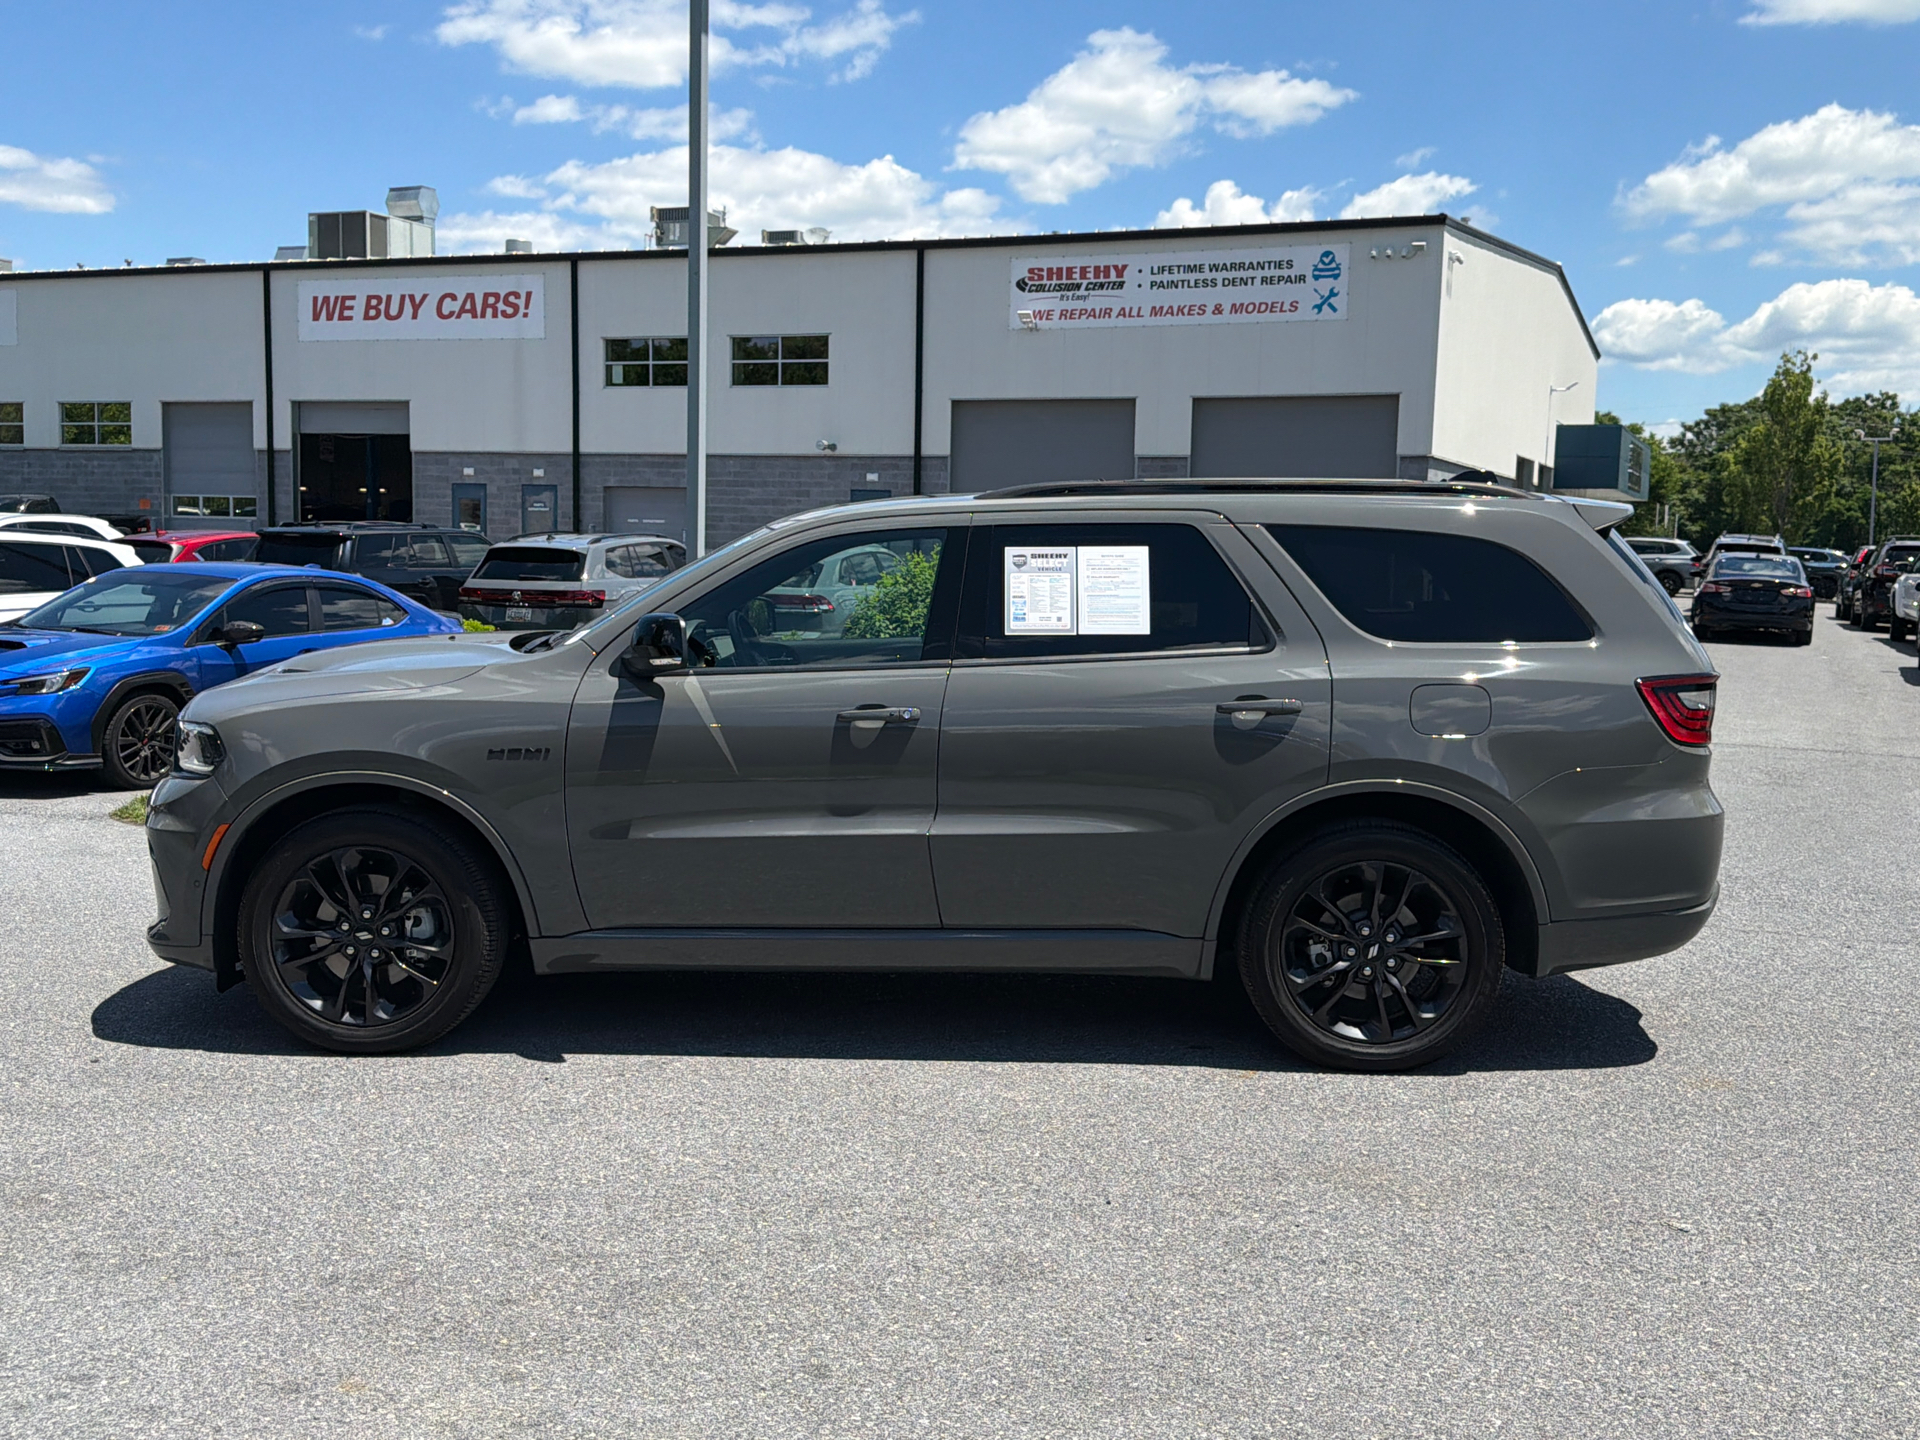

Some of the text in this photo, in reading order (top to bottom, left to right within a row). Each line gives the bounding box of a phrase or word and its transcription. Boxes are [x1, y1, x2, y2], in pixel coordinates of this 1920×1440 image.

[1027, 264, 1129, 281] SHEEHY
[1150, 259, 1294, 275] LIFETIME WARRANTIES
[1027, 280, 1126, 293] COLLISION CENTER
[1150, 274, 1307, 290] PAINTLESS DENT REPAIR
[1059, 292, 1091, 302] It's Easy!
[311, 290, 533, 322] WE BUY CARS!
[1032, 300, 1300, 321] WE REPAIR ALL MAKES & MODELS
[1030, 559, 1069, 567] SELECT
